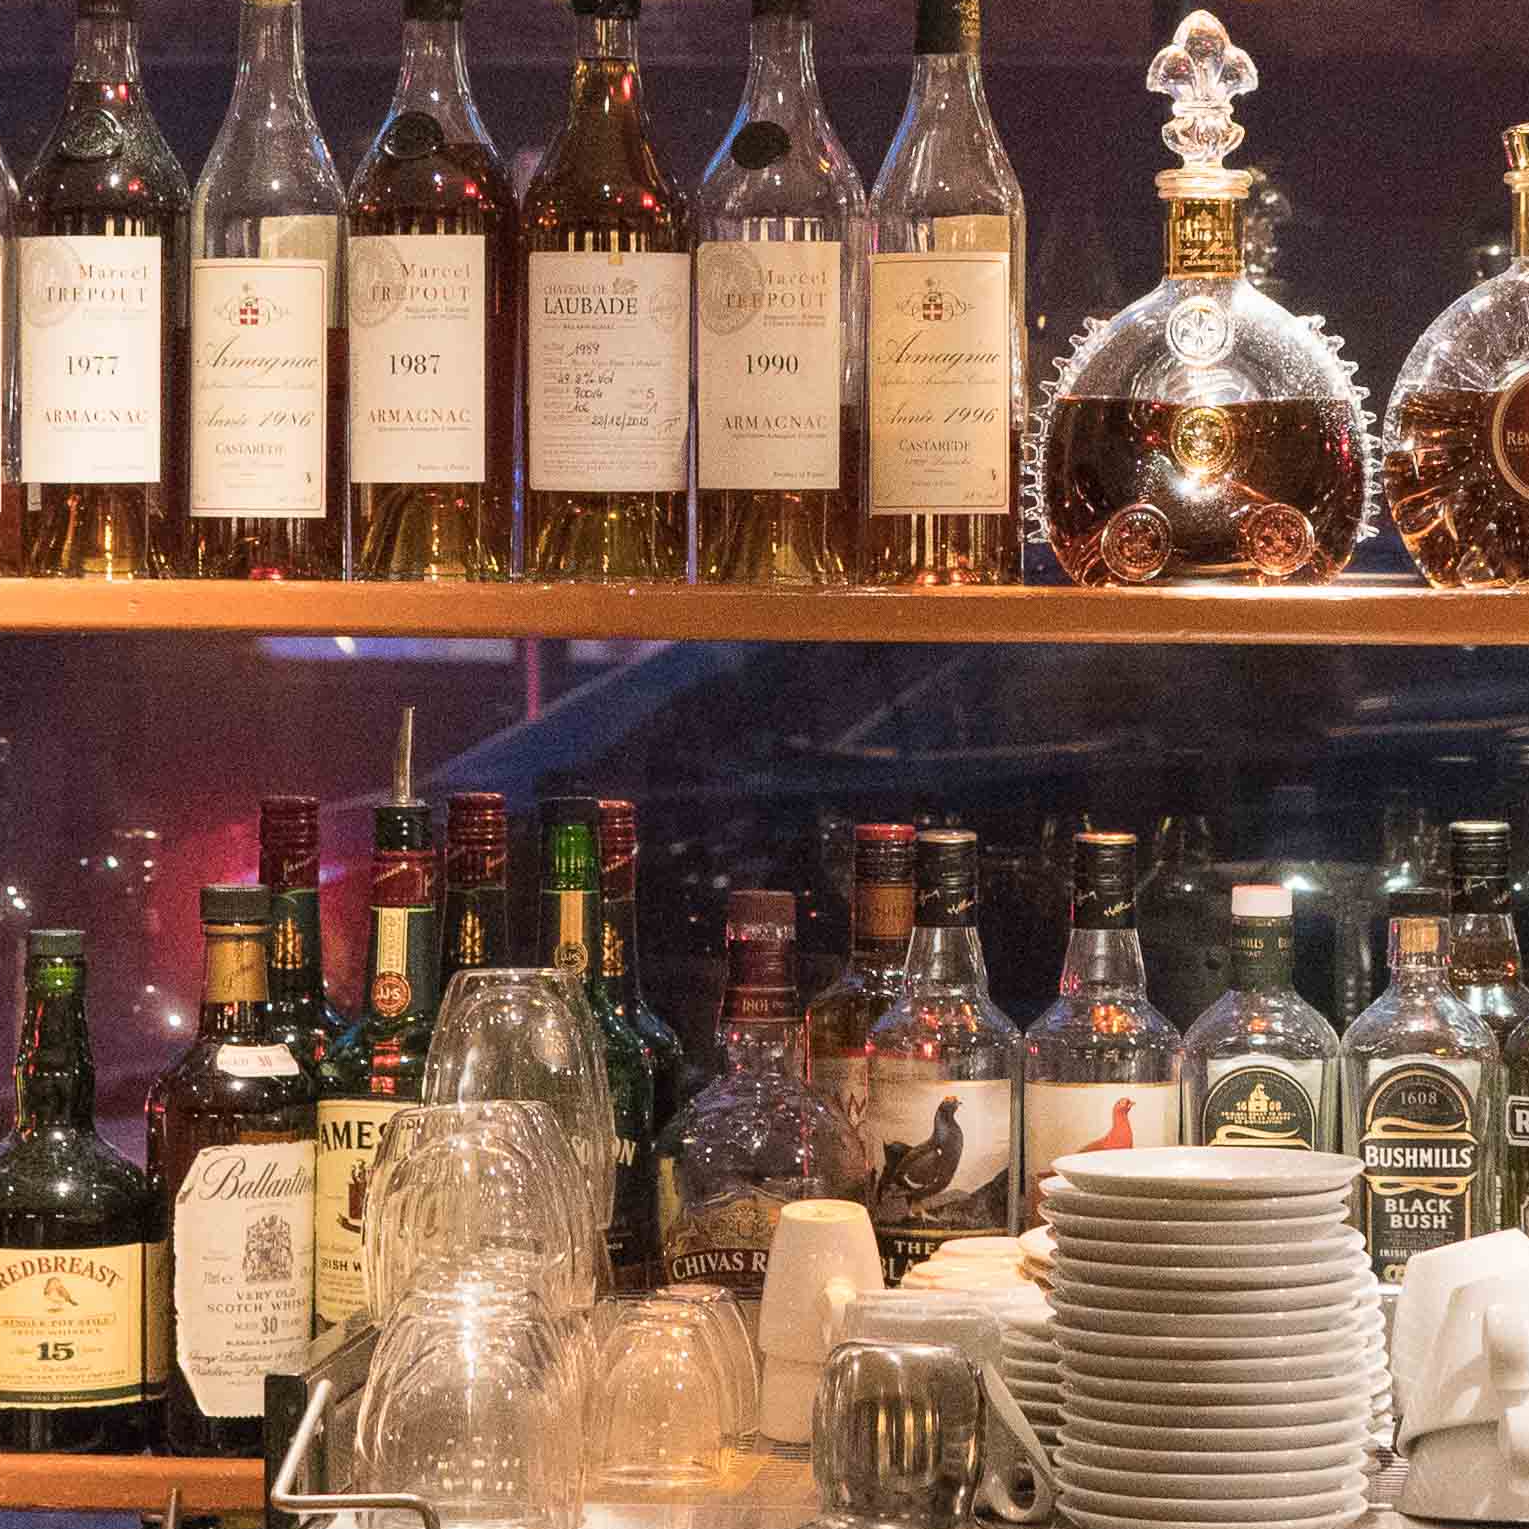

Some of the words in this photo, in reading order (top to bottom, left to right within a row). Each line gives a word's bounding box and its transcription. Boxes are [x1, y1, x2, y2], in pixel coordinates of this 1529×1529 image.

[78, 262, 149, 282] Marcel
[401, 262, 472, 281] Marcel
[757, 268, 828, 286] Marcel
[543, 296, 639, 316] LAUBADE
[65, 353, 120, 377] 1977
[388, 352, 442, 377] 1987
[744, 352, 800, 376] 1990
[41, 407, 149, 425] ARMAGNAC
[366, 406, 473, 425] ARMAGNAC
[722, 414, 829, 432] ARMAGNAC
[943, 406, 1000, 425] 1996
[1398, 1090, 1438, 1107] 1608
[1364, 1145, 1473, 1170] BUSHMILLS
[199, 1155, 313, 1202] Ballantin
[1384, 1198, 1454, 1216] BLACK
[1389, 1213, 1448, 1230] BUSH
[894, 1239, 936, 1256] THE
[671, 1252, 744, 1281] CHIVAS
[235, 1289, 271, 1302] VERY
[274, 1287, 298, 1300] OLD
[206, 1301, 264, 1315] SCOTCH
[270, 1298, 309, 1312] WHIS
[260, 1315, 280, 1335] 30
[35, 1340, 76, 1362] 15
